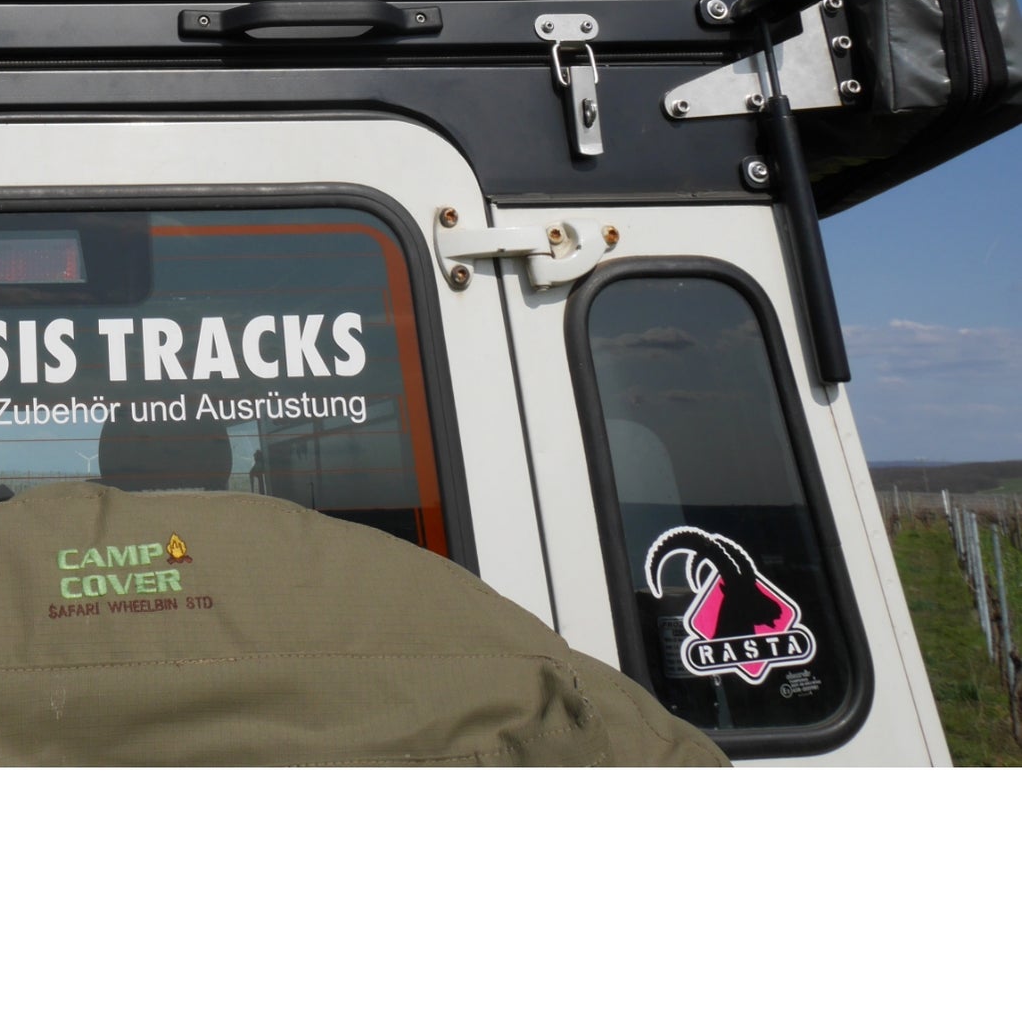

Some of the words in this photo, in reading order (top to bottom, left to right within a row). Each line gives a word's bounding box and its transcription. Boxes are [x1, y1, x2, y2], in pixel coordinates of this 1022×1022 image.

[98, 312, 366, 381] TRACKS
[131, 394, 186, 422] und
[195, 391, 366, 423] Ausrüstung
[57, 542, 164, 570] CAMP
[60, 568, 183, 599] COVER
[48, 602, 100, 619] SAFARI
[107, 598, 178, 613] WHEELBIN
[186, 596, 214, 610] STD
[698, 635, 803, 665] RASTA
